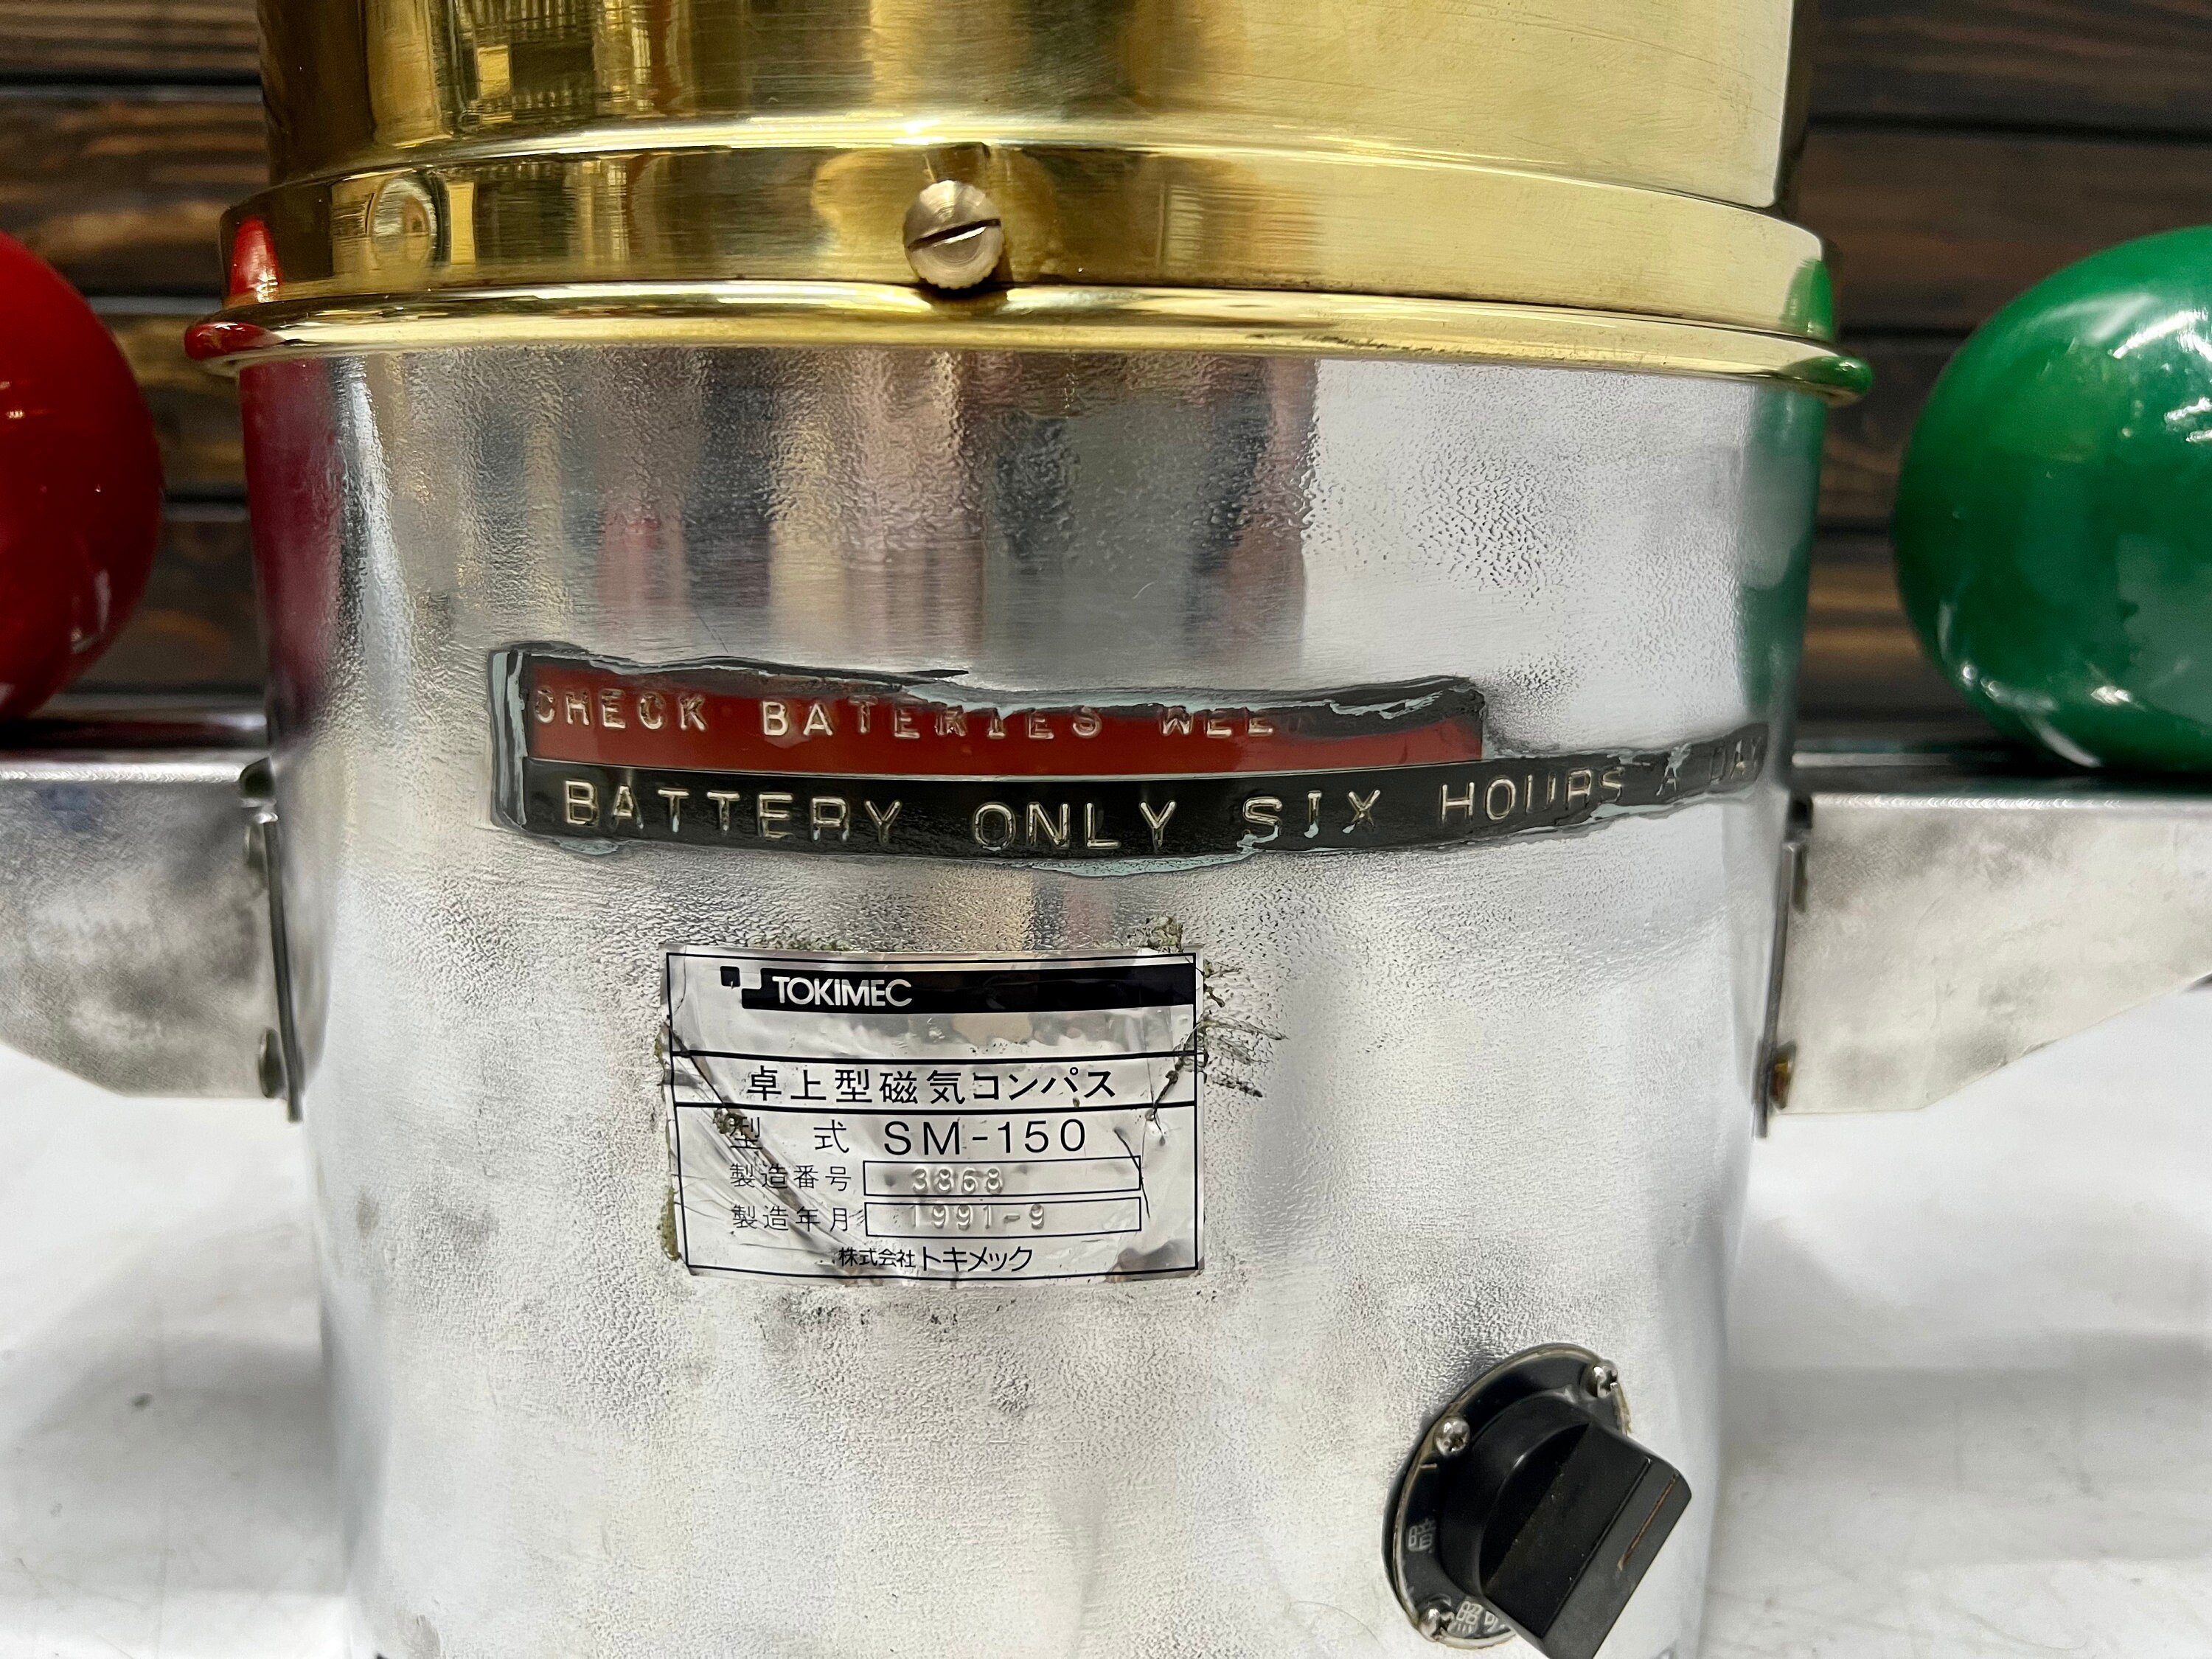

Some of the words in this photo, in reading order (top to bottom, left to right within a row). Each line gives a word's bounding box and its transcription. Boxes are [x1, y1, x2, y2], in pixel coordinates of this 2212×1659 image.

[533, 686, 709, 732] CHECK
[564, 779, 901, 844] BATTERY
[973, 800, 1178, 852] ONLY
[1240, 790, 1381, 846] SIX
[771, 975, 913, 1007] TOKIMEC
[746, 1065, 1116, 1105] 卓上型磁気コンパス
[883, 1118, 1086, 1155] SM-150
[730, 1162, 852, 1192] 製造番号
[911, 1166, 1004, 1194] 3868
[731, 1203, 849, 1232] 製造年月
